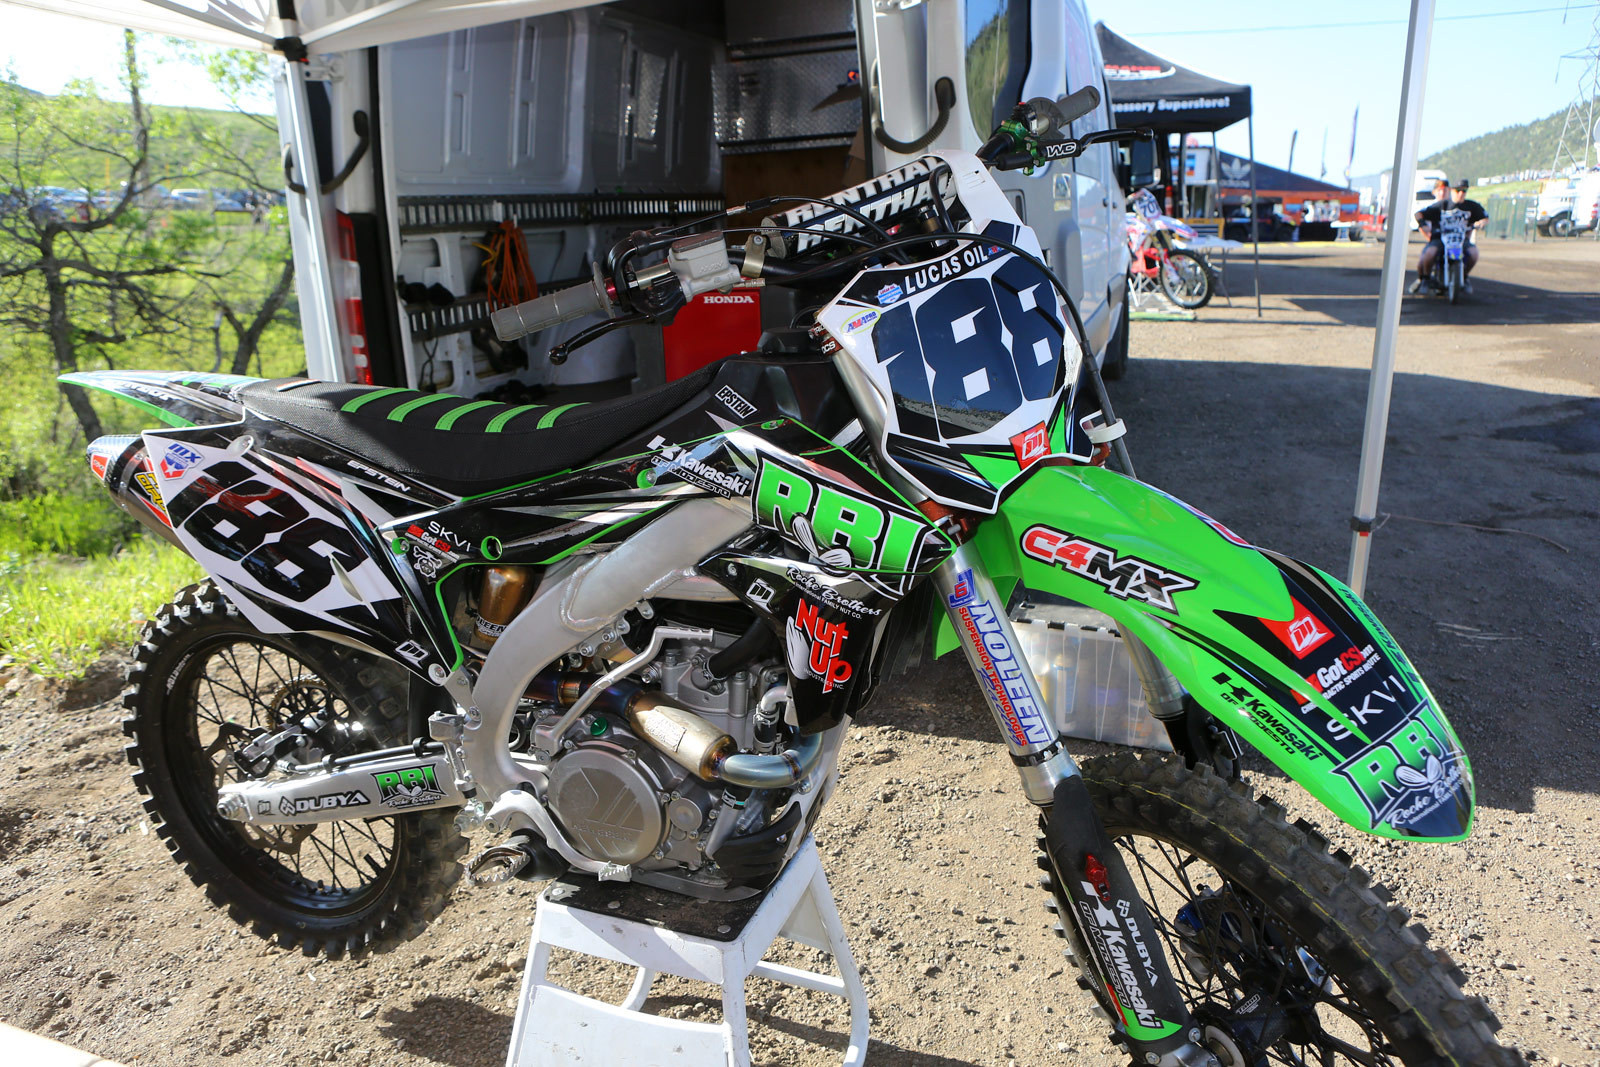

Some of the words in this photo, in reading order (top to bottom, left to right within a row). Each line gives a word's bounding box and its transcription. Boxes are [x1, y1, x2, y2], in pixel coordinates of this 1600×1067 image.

[1157, 96, 1230, 112] Superstore!
[904, 255, 962, 295] LUCAS
[963, 245, 989, 268] OIL
[703, 295, 754, 304] HONDA
[872, 256, 1065, 441] 188
[717, 387, 754, 416] EPSTEIN
[347, 459, 411, 492] EPSTEIN
[669, 464, 731, 499] MODESTO
[675, 448, 750, 496] Kawasaki
[166, 461, 369, 603] 188
[428, 520, 471, 552] SKVI
[757, 459, 927, 588] RBI
[1021, 524, 1198, 614] C4MX
[820, 585, 883, 616] Brothers
[821, 597, 840, 610] FAMILY
[840, 605, 851, 616] NUT
[851, 611, 862, 619] CO.
[795, 598, 849, 658] Nut
[809, 640, 852, 694] Up
[832, 682, 844, 690] INC.
[958, 606, 993, 670] SUSPENSION
[988, 670, 1027, 746] TECHNOLOGIES
[967, 600, 1052, 744] NOLEEN
[1343, 667, 1365, 685] SPORTS
[1220, 693, 1238, 705] OF
[1245, 699, 1323, 761] Kawasaki
[376, 766, 441, 801] RBI
[1342, 703, 1458, 817] RBI
[296, 791, 369, 813] DUBYA
[1089, 924, 1132, 1008] MODESTO
[1124, 917, 1159, 988] DUBYA
[1102, 929, 1165, 1029] Kawasaki
